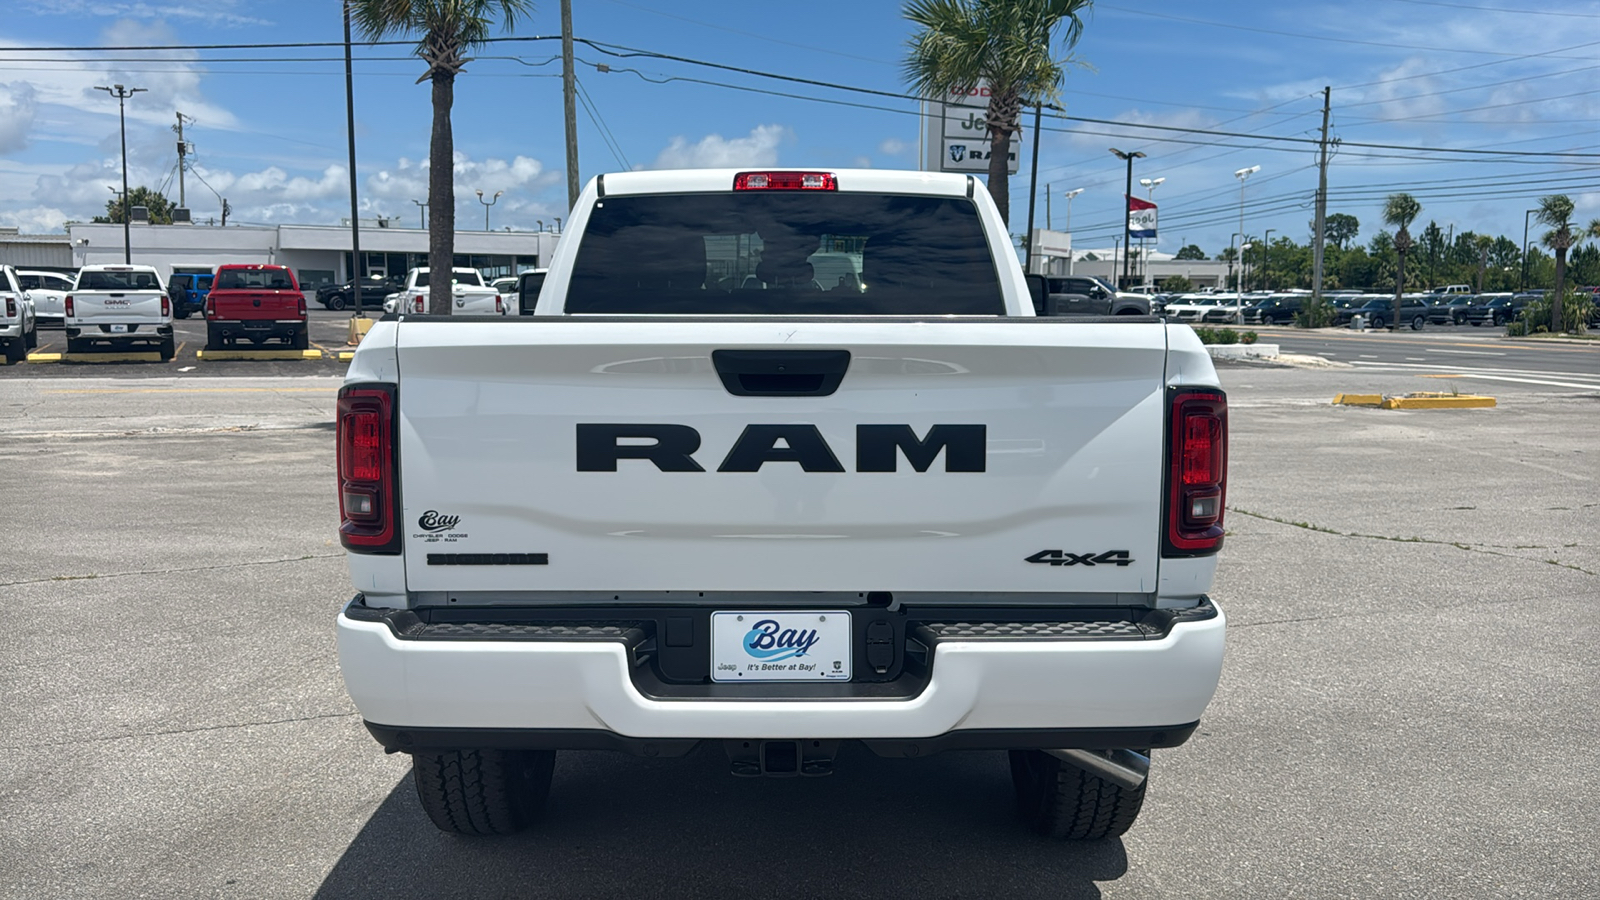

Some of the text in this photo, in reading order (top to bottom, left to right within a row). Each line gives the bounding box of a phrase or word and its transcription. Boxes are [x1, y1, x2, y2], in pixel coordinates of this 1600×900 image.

[951, 85, 993, 97] DOD
[576, 423, 987, 473] RAM
[420, 509, 461, 531] Bay
[1024, 549, 1136, 566] 4x4
[748, 619, 820, 658] Bay
[717, 662, 738, 672] Jeep
[747, 663, 817, 672] It's Better at Bay!
